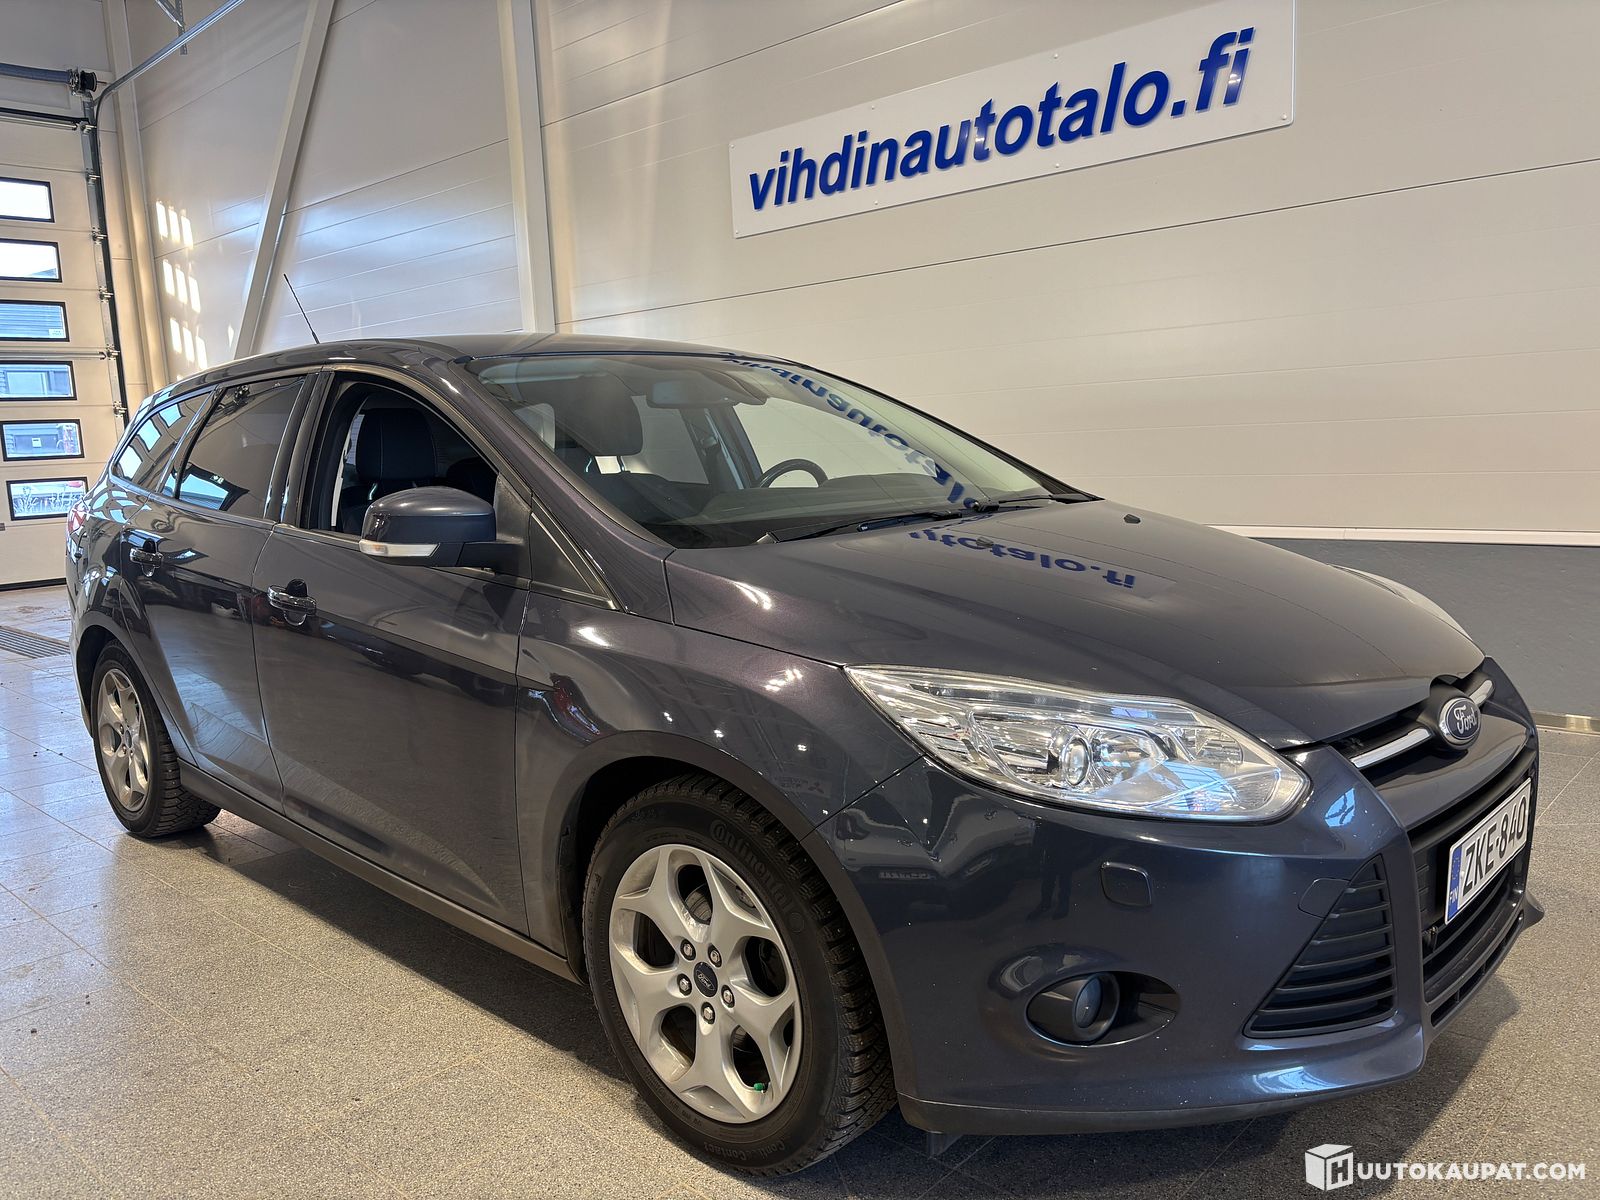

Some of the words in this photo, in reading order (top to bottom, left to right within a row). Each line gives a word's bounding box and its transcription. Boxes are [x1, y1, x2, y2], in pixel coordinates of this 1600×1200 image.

[749, 27, 1254, 210] vihdinautotalo.fi
[1453, 704, 1478, 735] Ford
[1462, 796, 1527, 897] ZKE-840
